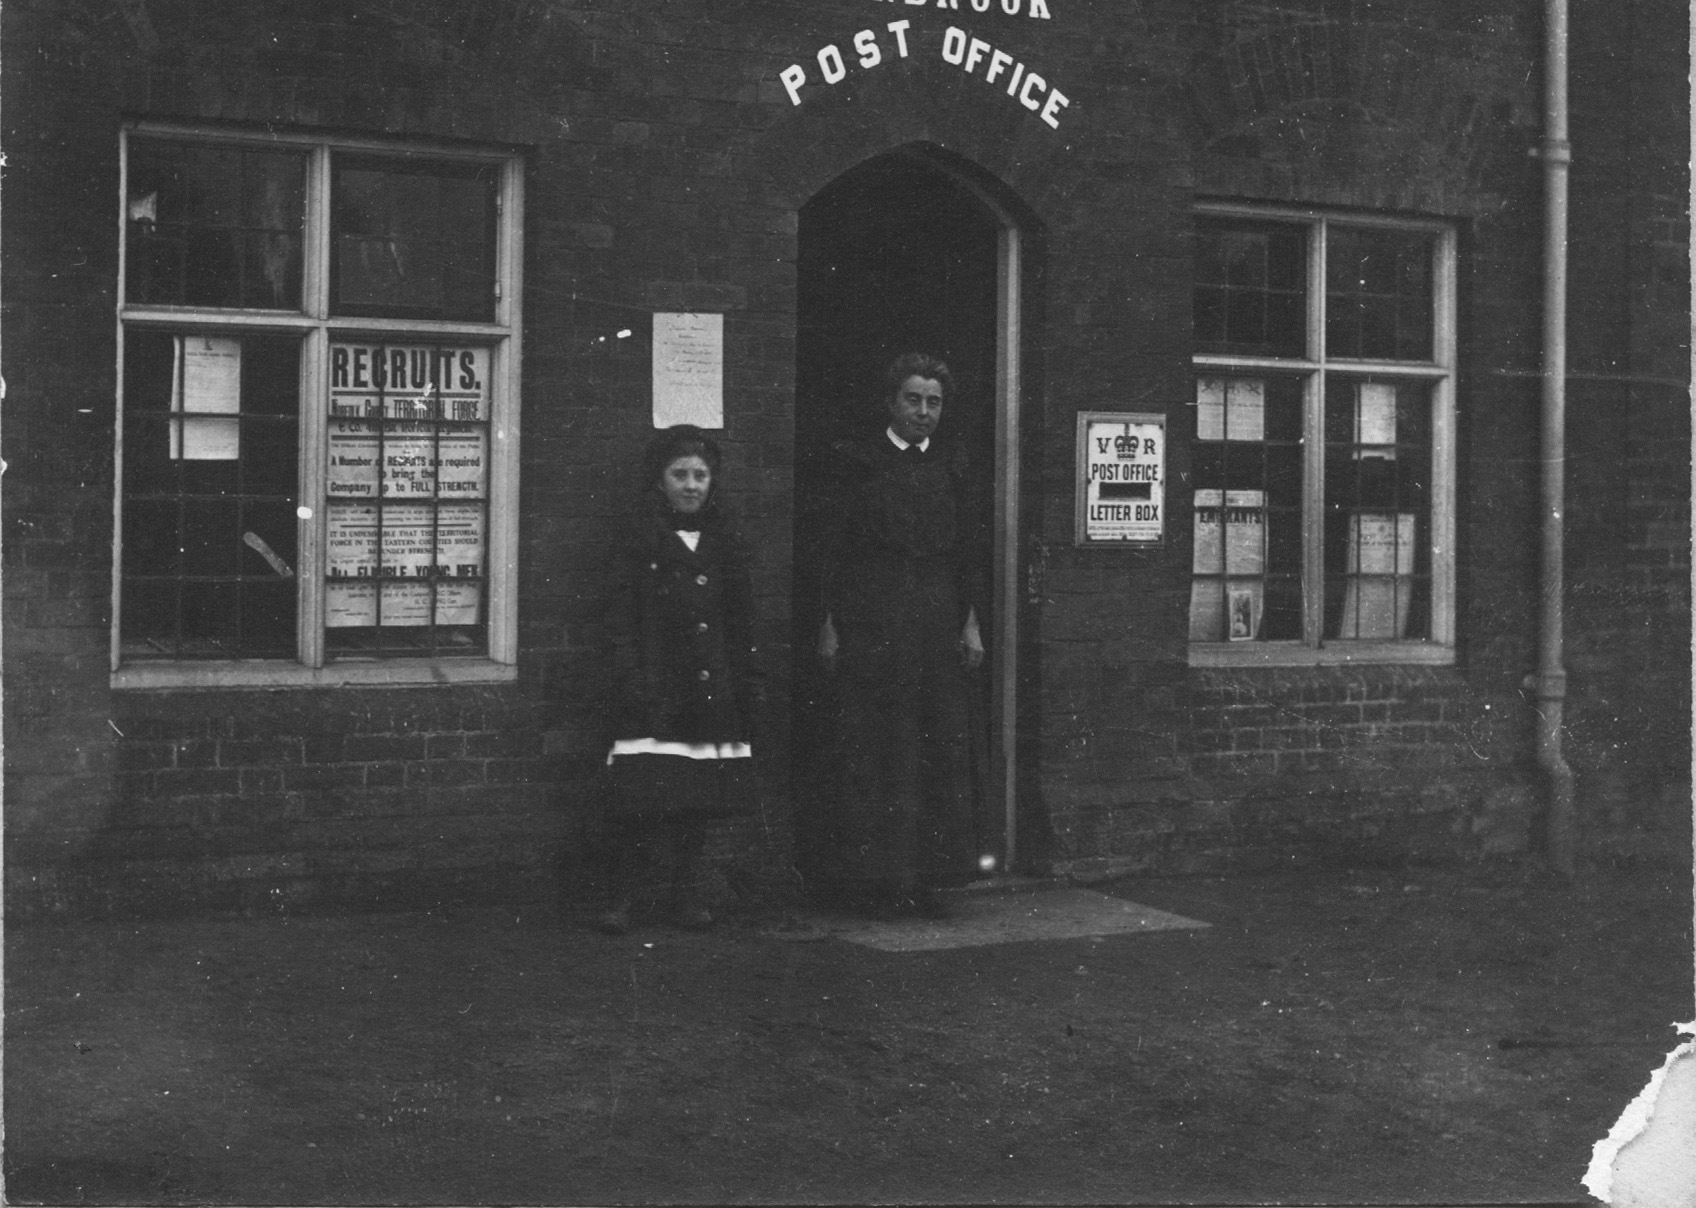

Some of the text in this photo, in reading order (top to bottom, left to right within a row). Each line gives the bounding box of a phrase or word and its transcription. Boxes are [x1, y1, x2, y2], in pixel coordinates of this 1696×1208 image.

[779, 20, 1070, 129] POST OFFICE
[332, 347, 481, 390] RECRUITS.
[1096, 437, 1156, 455] V R
[331, 456, 337, 466] A
[339, 456, 372, 466] Number
[445, 456, 480, 469] required
[392, 468, 415, 481] bring
[1091, 463, 1159, 481] POST OFFICE
[331, 482, 371, 494] Company
[395, 482, 405, 492] to
[411, 481, 430, 492] FULL
[1090, 504, 1159, 521] LETTER BOX
[349, 530, 396, 538] UNDESIBLE
